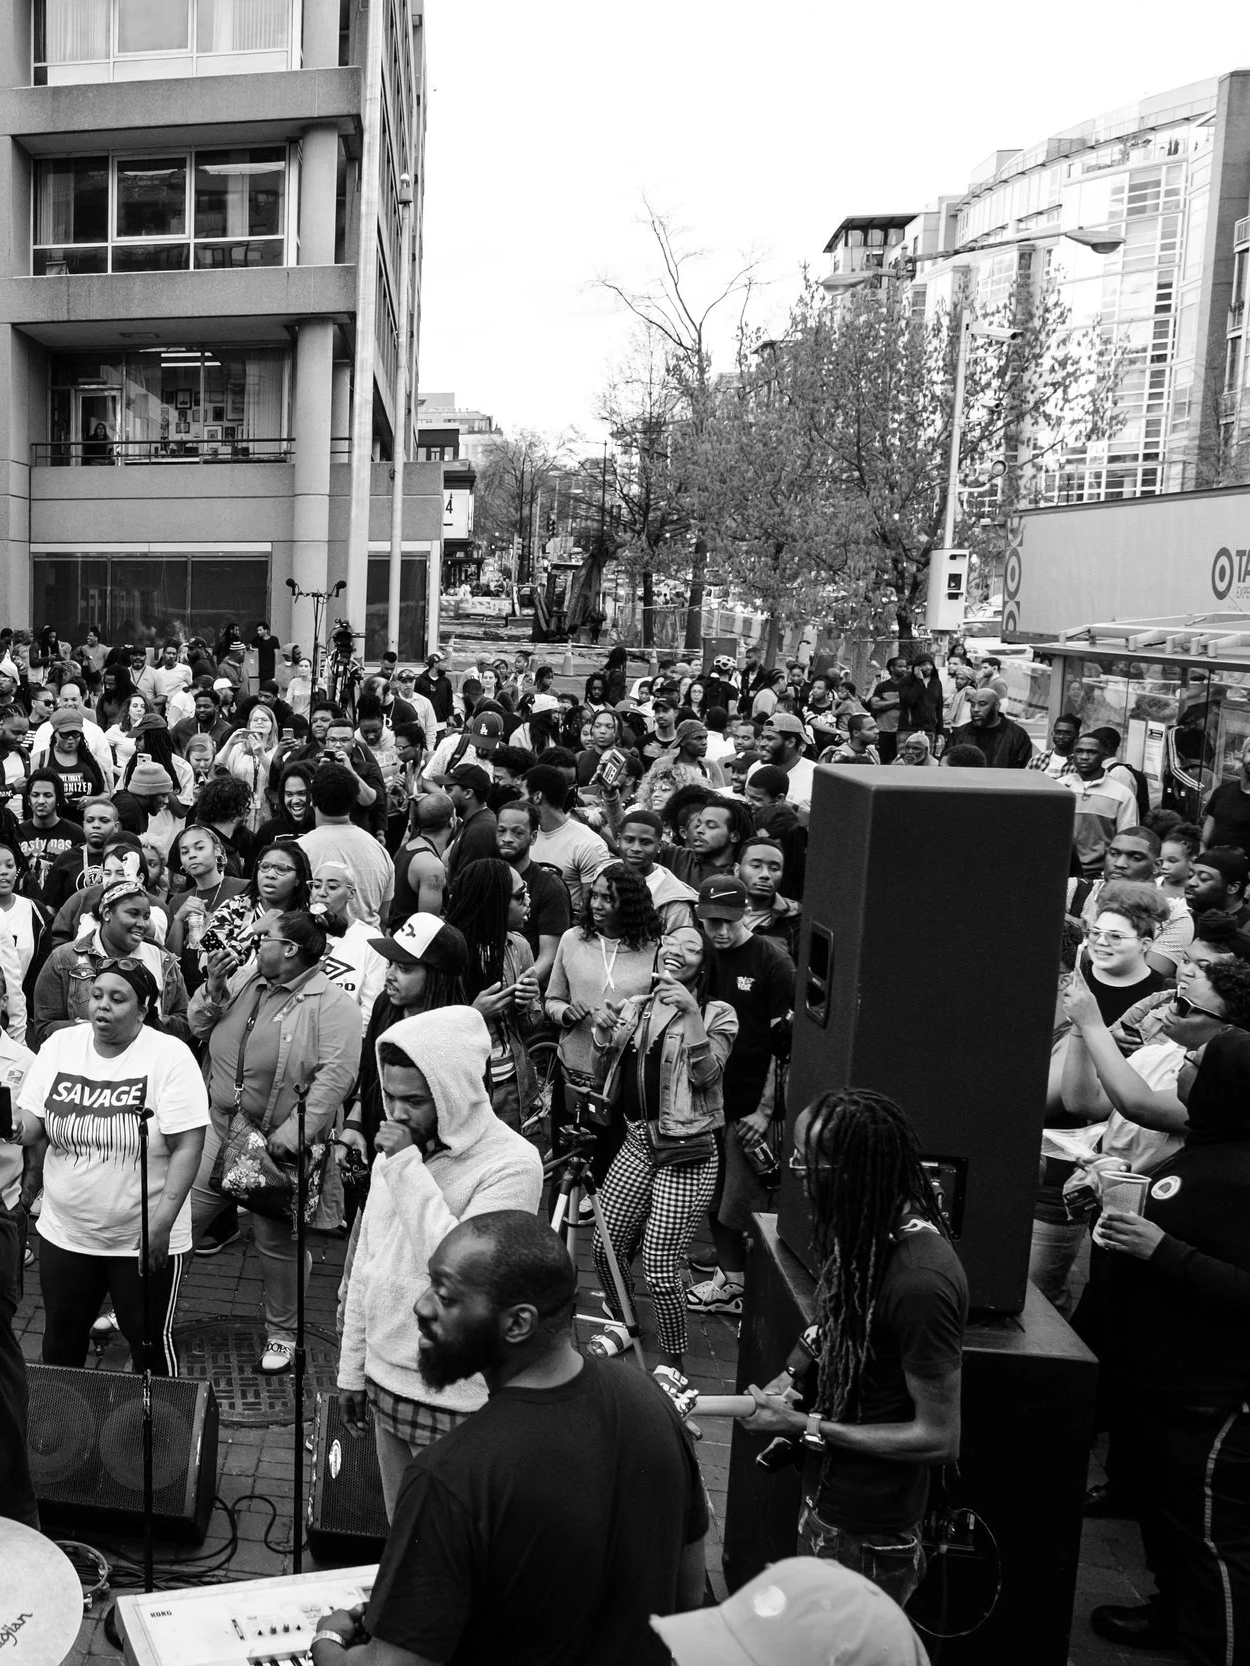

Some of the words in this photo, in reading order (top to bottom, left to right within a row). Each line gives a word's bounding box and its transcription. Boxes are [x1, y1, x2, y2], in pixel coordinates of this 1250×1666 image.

[50, 839, 72, 855] nas
[52, 1081, 143, 1108] SAVAGE
[150, 1610, 173, 1618] KORG
